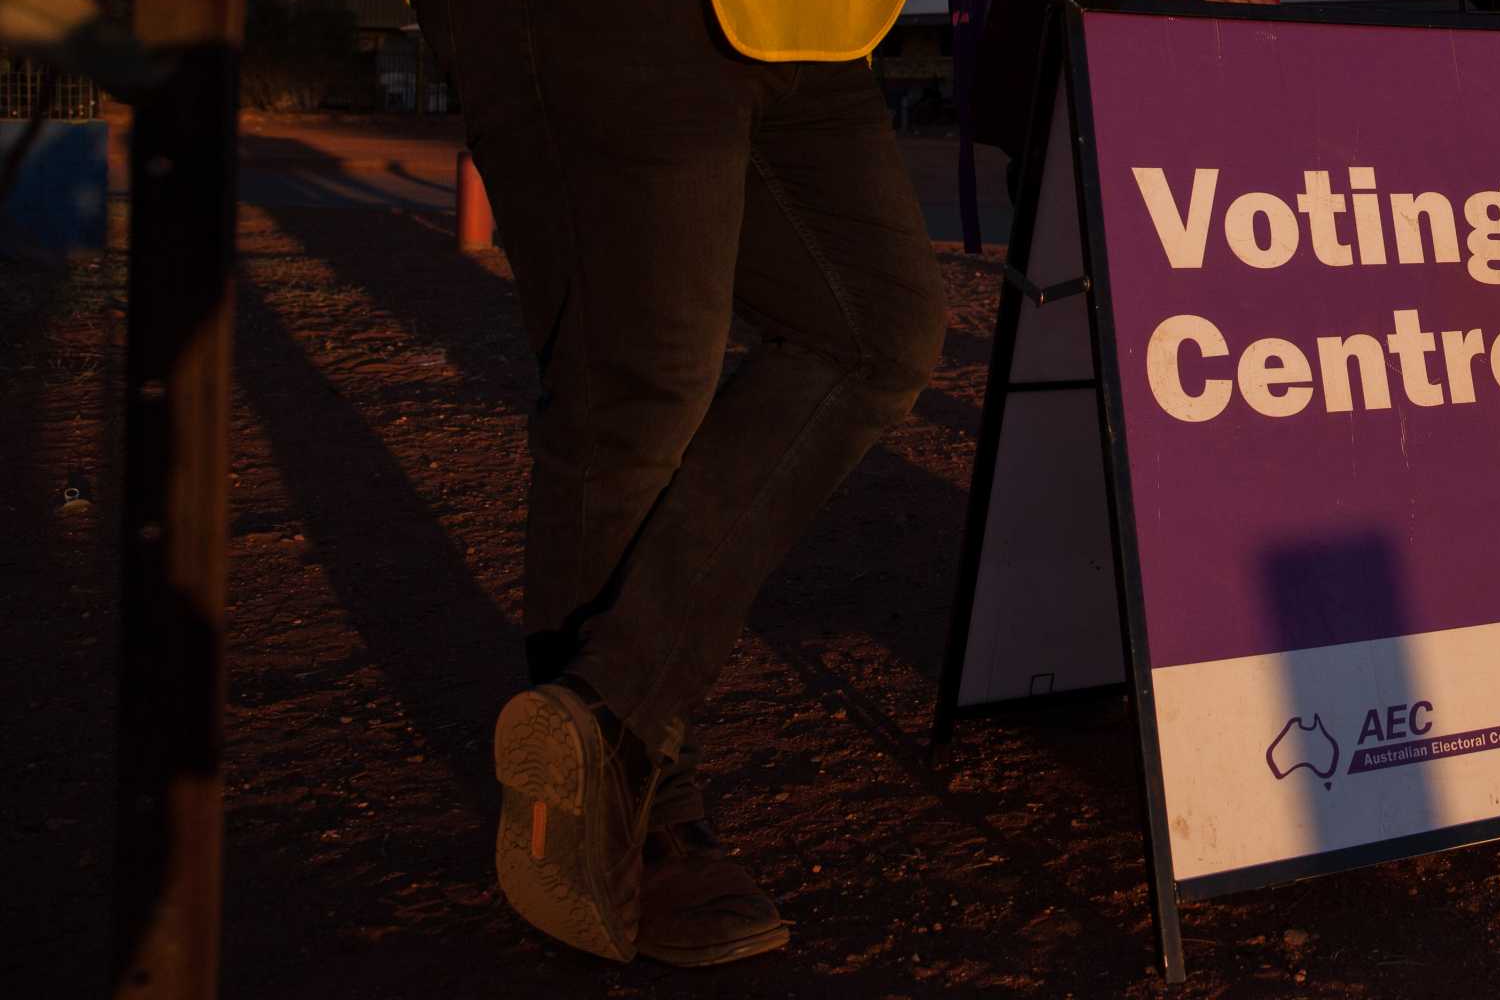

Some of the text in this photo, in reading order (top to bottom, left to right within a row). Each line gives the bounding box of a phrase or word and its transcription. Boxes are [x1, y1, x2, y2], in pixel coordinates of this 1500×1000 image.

[1357, 700, 1434, 745] AEC
[1363, 745, 1428, 767] Australian
[1431, 733, 1486, 755] Electoral
